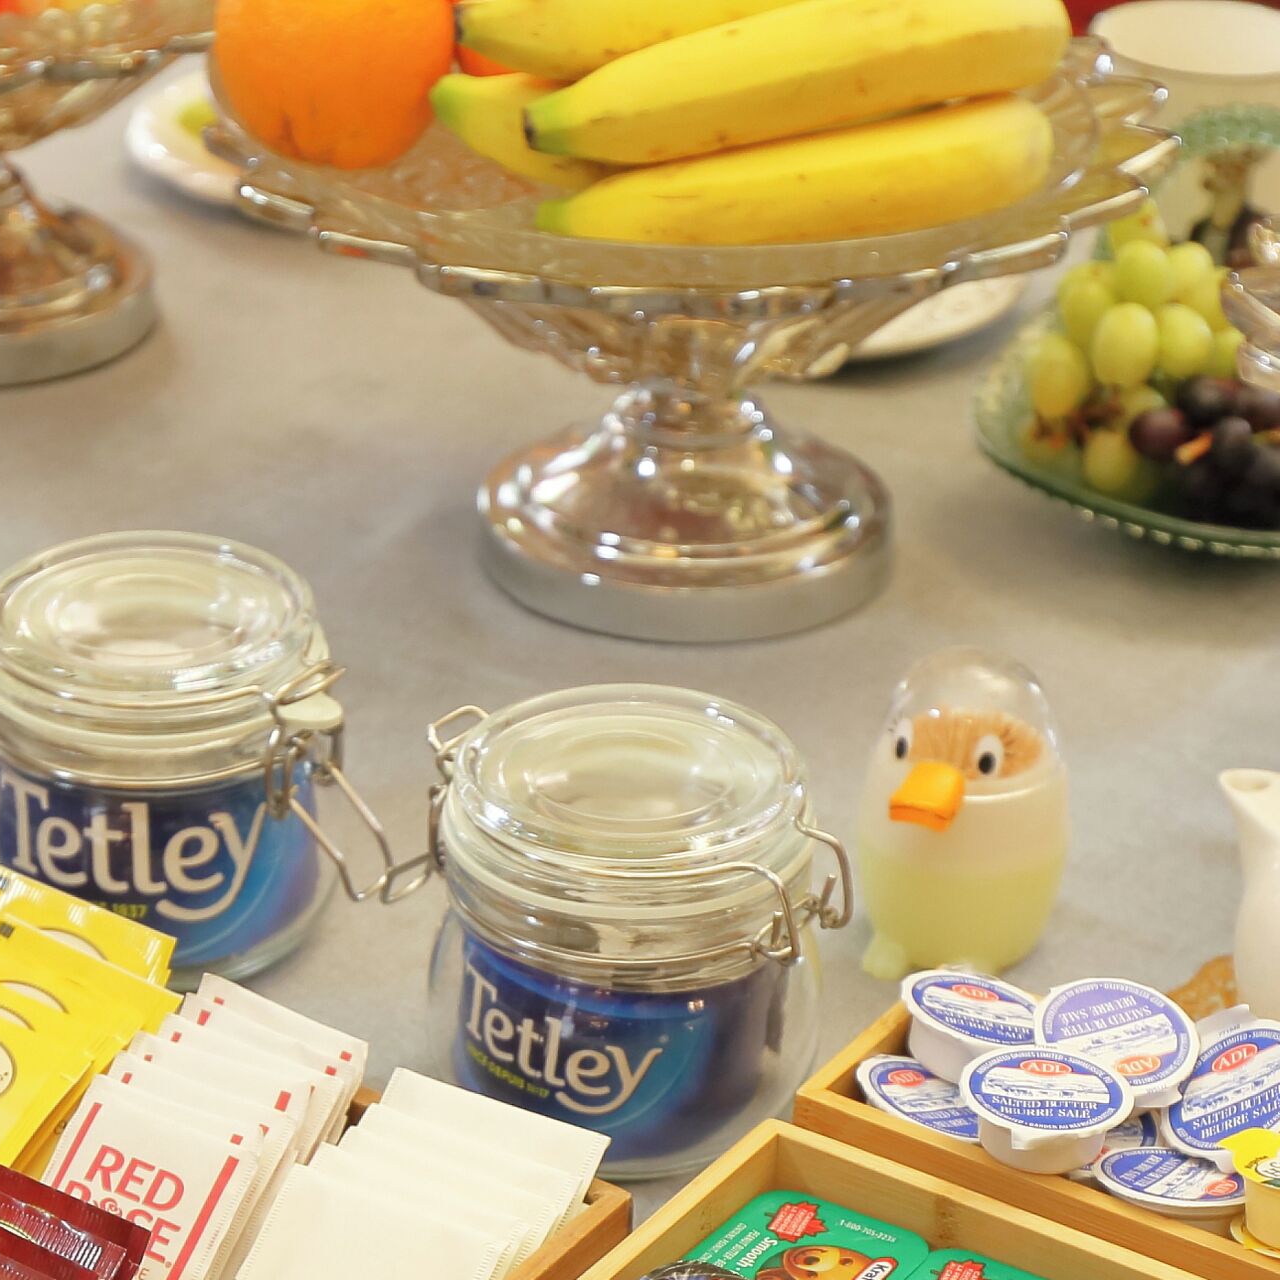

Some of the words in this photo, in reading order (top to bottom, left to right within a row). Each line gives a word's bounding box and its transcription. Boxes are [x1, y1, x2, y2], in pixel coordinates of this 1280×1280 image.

[0, 767, 268, 923] Tetley
[1088, 994, 1137, 1013] BEURRE
[1108, 1004, 1152, 1027] SALTED
[464, 949, 664, 1116] Tetley
[1060, 1018, 1106, 1037] BUTTER
[1027, 1061, 1069, 1074] ADL
[1117, 1056, 1154, 1074] ADL
[1217, 1049, 1254, 1070] ADL
[991, 1095, 1042, 1108] SALTED
[1045, 1099, 1098, 1111] BUTTER
[1000, 1105, 1055, 1118] BEURRE
[1192, 1105, 1237, 1130] SALTED
[1200, 1113, 1250, 1139] BEURRE
[84, 1144, 185, 1212] RED
[736, 1236, 778, 1269] Smooth
